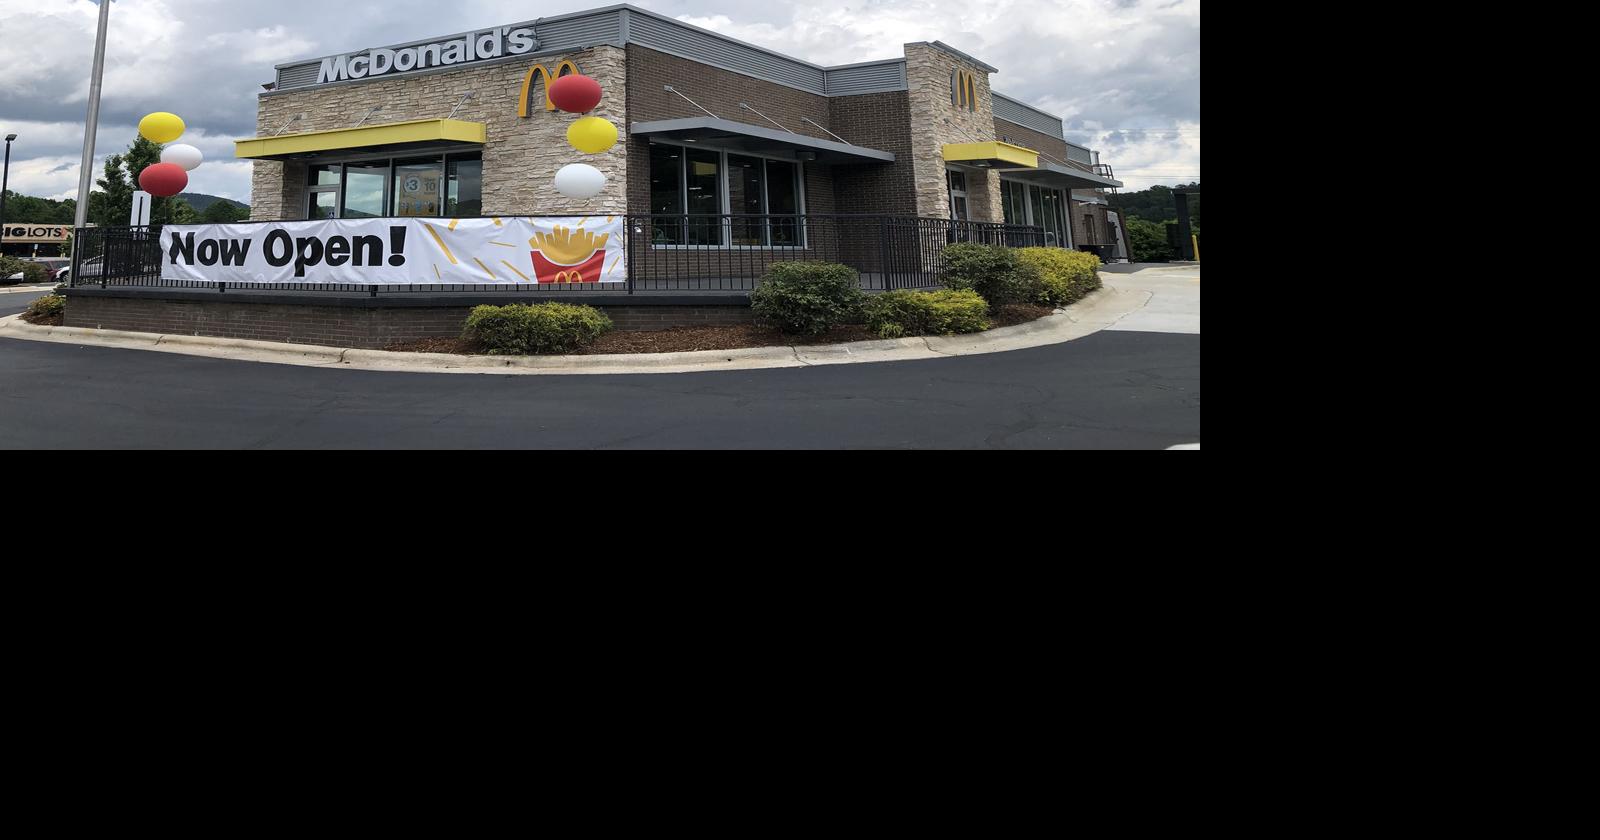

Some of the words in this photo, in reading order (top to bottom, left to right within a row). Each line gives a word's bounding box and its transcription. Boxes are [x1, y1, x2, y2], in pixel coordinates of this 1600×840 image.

[316, 26, 537, 84] McDonald's
[0, 227, 26, 237] IG
[28, 227, 62, 237] LOTS
[169, 230, 251, 266] Now
[263, 225, 407, 278] Open!
